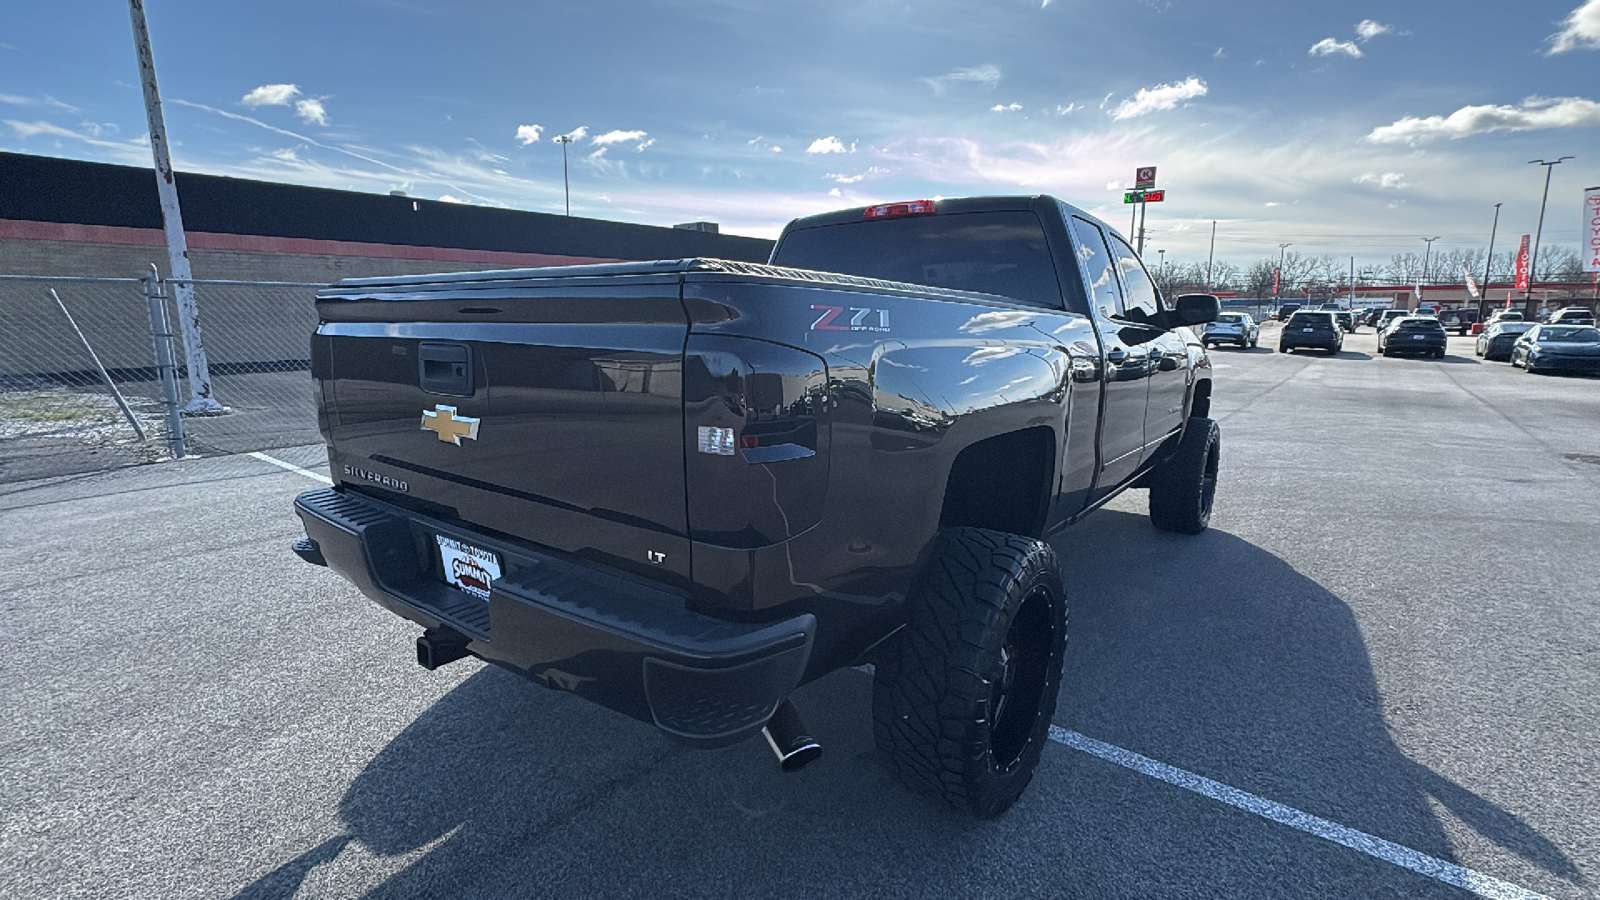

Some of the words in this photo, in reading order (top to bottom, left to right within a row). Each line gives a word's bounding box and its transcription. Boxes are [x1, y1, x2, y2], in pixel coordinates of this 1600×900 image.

[810, 304, 890, 330] Z71
[344, 464, 408, 492] SILVERADO
[647, 550, 666, 564] LT
[453, 560, 492, 590] SUMMIT
